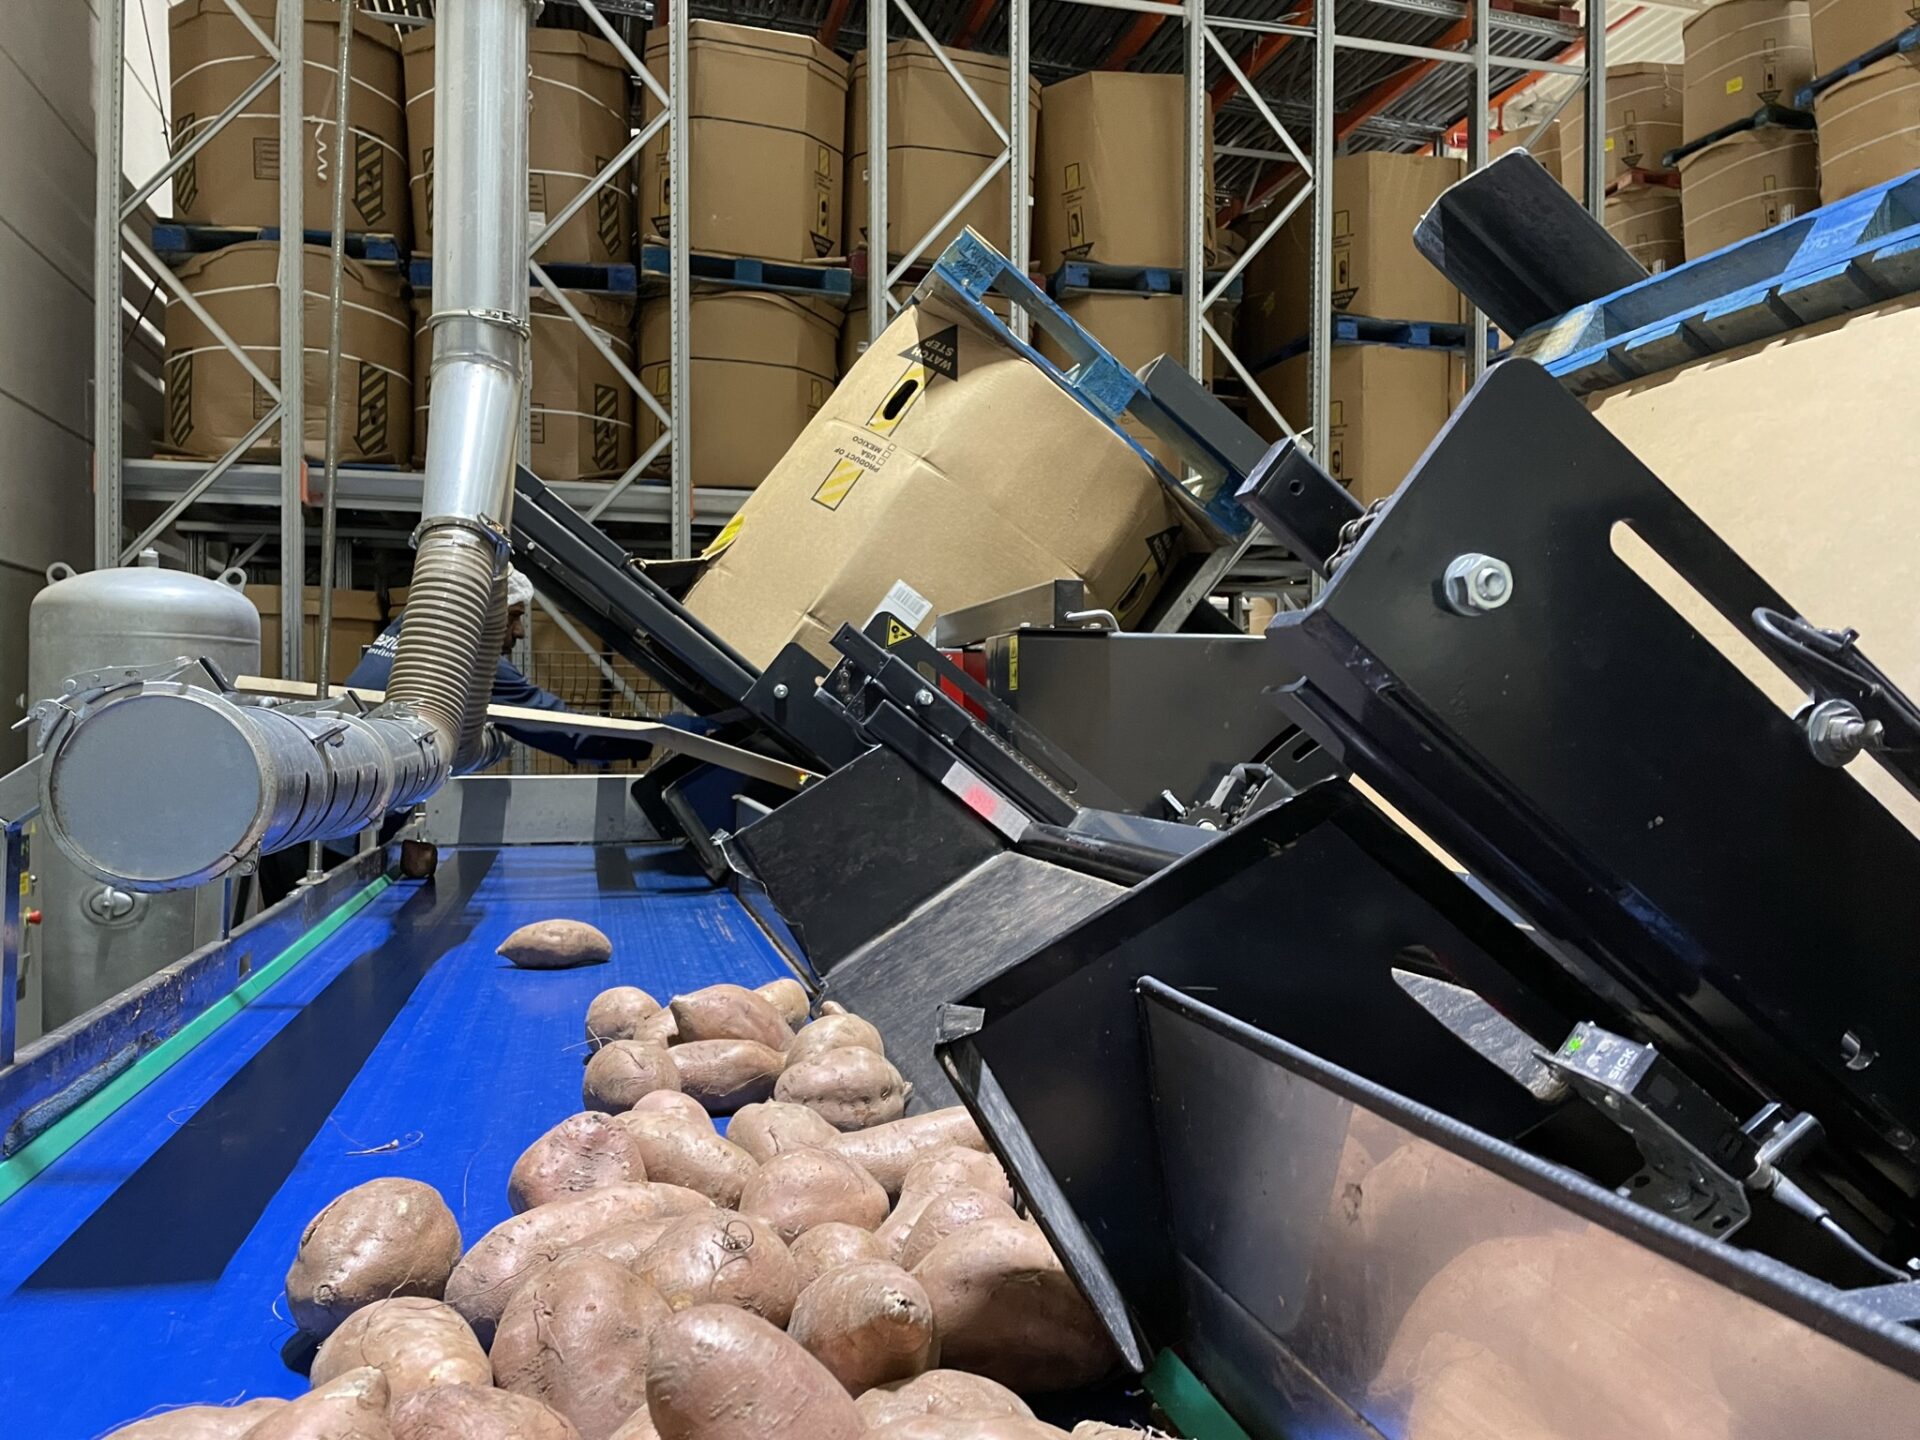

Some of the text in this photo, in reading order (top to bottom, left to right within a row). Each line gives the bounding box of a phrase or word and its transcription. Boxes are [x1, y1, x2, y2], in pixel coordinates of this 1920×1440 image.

[911, 346, 952, 371] WATCH
[924, 340, 955, 357] STEP
[852, 435, 883, 454] MEXICO
[861, 449, 877, 461] USA
[833, 447, 880, 473] PRODUCT OF
[1607, 1047, 1636, 1080] SICK
